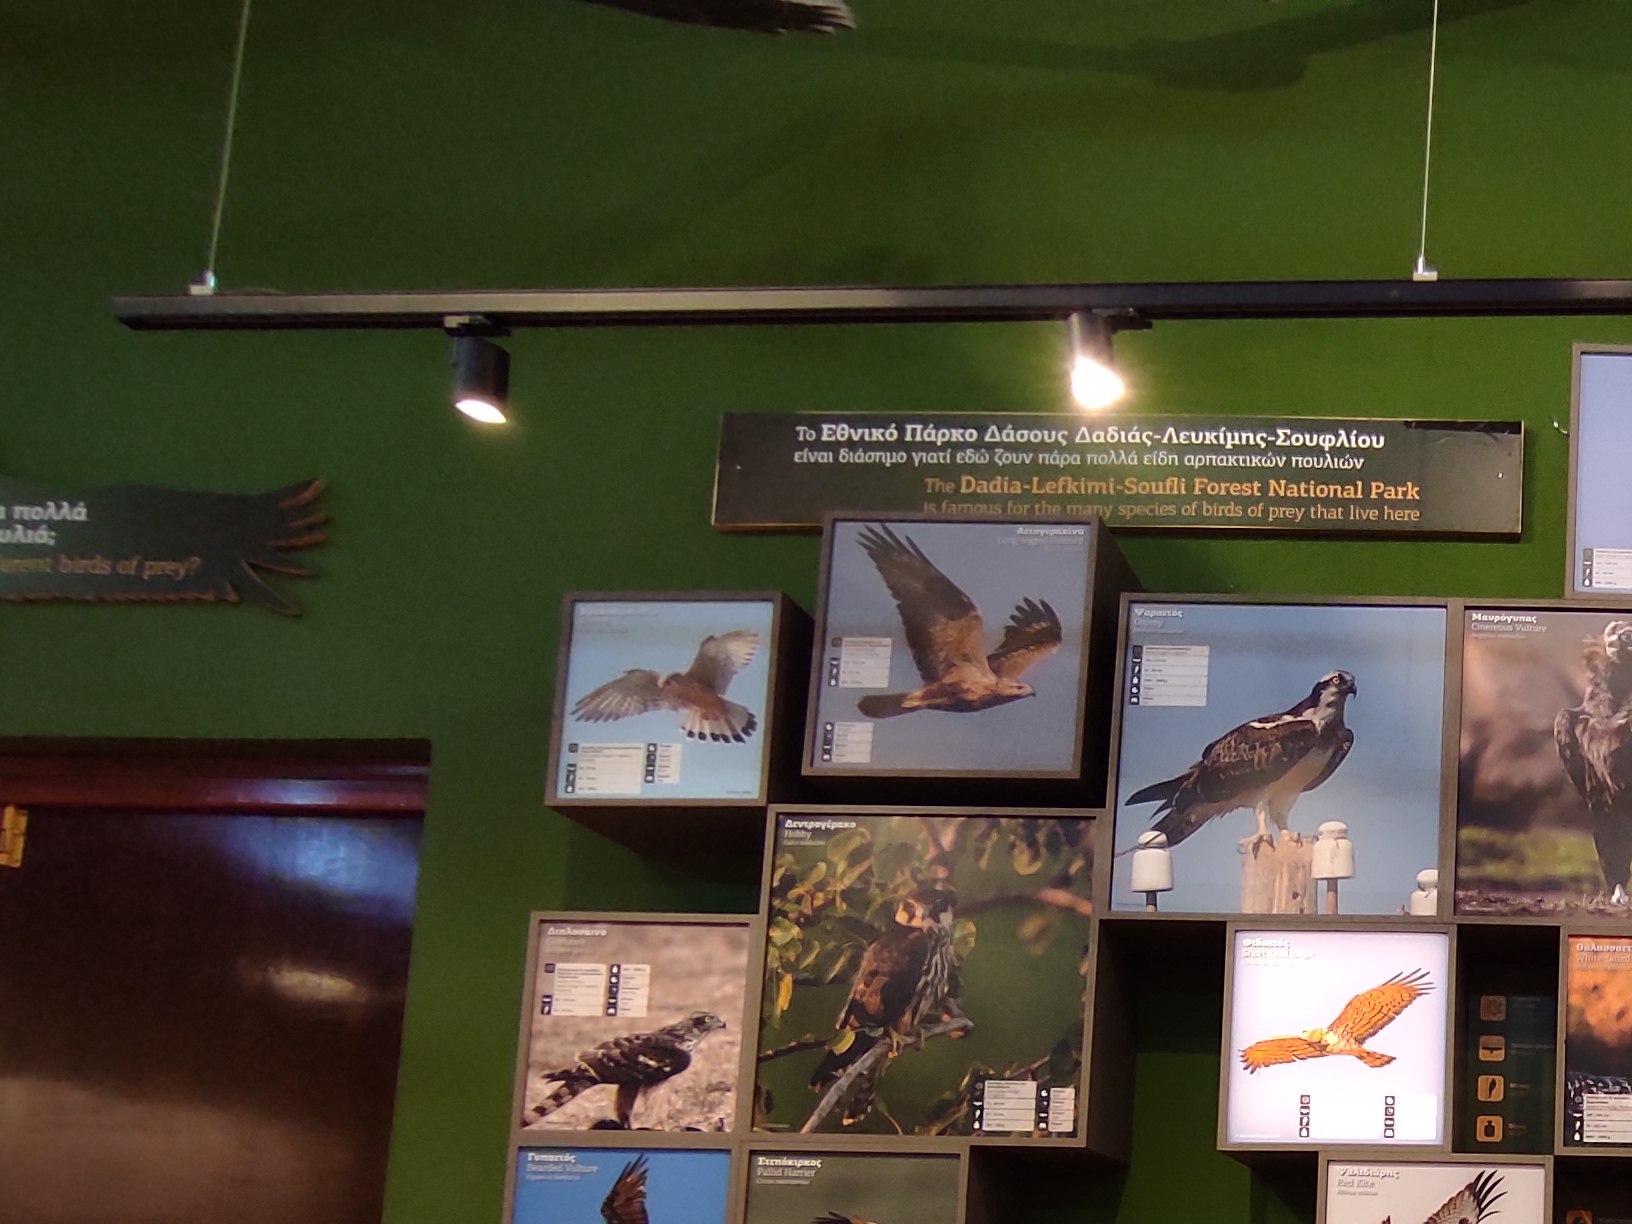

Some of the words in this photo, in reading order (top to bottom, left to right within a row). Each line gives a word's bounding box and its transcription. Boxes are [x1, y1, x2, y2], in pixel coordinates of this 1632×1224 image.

[796, 425, 816, 442] Το
[820, 422, 899, 442] Εθνικό
[904, 424, 978, 446] Πάρκο
[984, 424, 1068, 446] Δάσους
[1075, 425, 1386, 450] Δαδιάς-Λευκίμης-Σουφλίου
[793, 448, 833, 464] είναι
[838, 447, 907, 467] διάσημο
[911, 448, 951, 467] γιατί
[956, 448, 988, 465] εδώ
[994, 449, 1033, 467] ζουν
[1038, 449, 1081, 468] πάρα
[1086, 450, 1138, 466] πολλά
[1143, 450, 1179, 468] είδη
[1184, 452, 1286, 470] αρπακτικών
[1291, 452, 1364, 470] πουλιών
[924, 476, 956, 494] The
[960, 475, 1186, 496] Dadia-Lefkimi-Soufli
[1193, 477, 1261, 497] Forest
[1268, 478, 1363, 499] National
[1370, 480, 1420, 500] Park
[12, 501, 88, 521] πολλά
[1007, 500, 1030, 514] for
[1034, 501, 1061, 515] the
[1066, 503, 1113, 519] many
[1118, 502, 1177, 518] species
[1181, 502, 1199, 516] of
[1202, 502, 1243, 517] birds
[1247, 502, 1264, 517] of
[1268, 505, 1305, 522] prey
[1310, 504, 1344, 520] that
[1349, 504, 1379, 520] live
[1383, 504, 1420, 521] here
[0, 525, 56, 546] υλιά;
